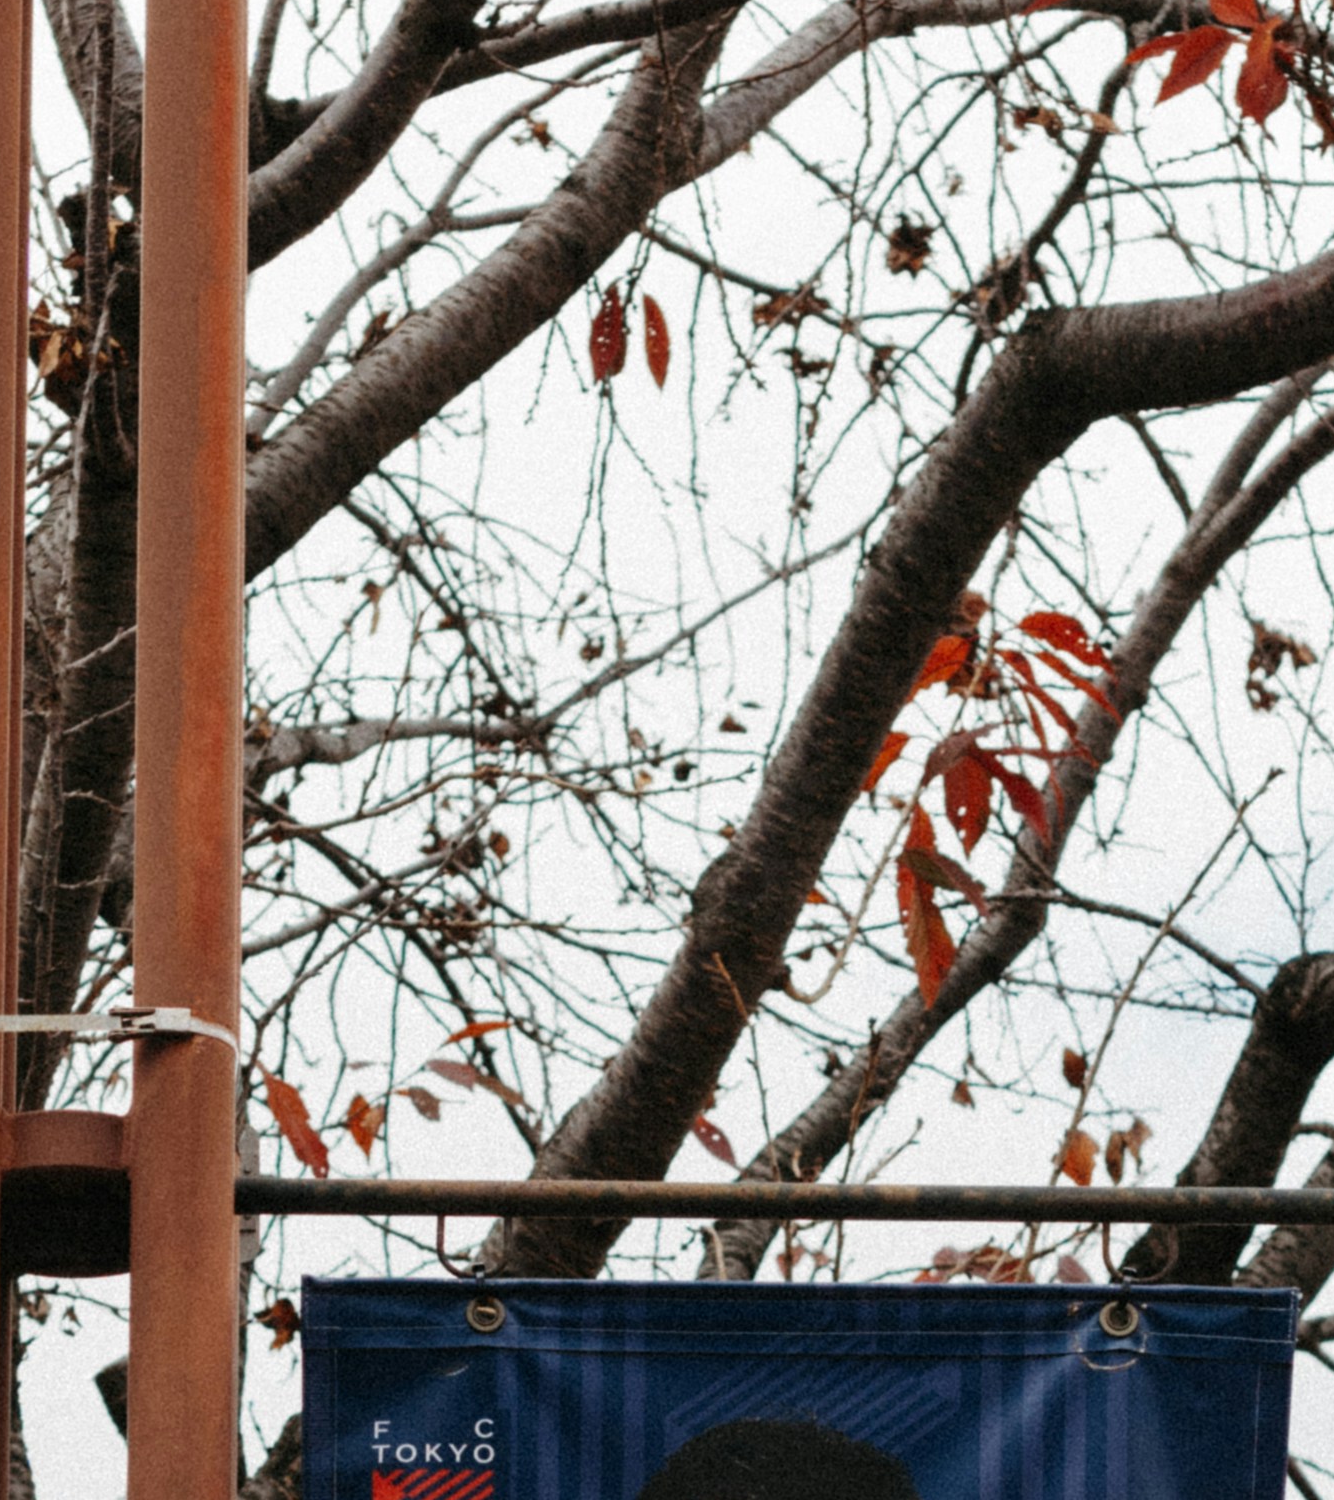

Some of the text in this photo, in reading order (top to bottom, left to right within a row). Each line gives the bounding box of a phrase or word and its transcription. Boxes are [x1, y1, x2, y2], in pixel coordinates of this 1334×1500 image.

[373, 1418, 494, 1439] F C
[371, 1442, 495, 1463] TOKYO
